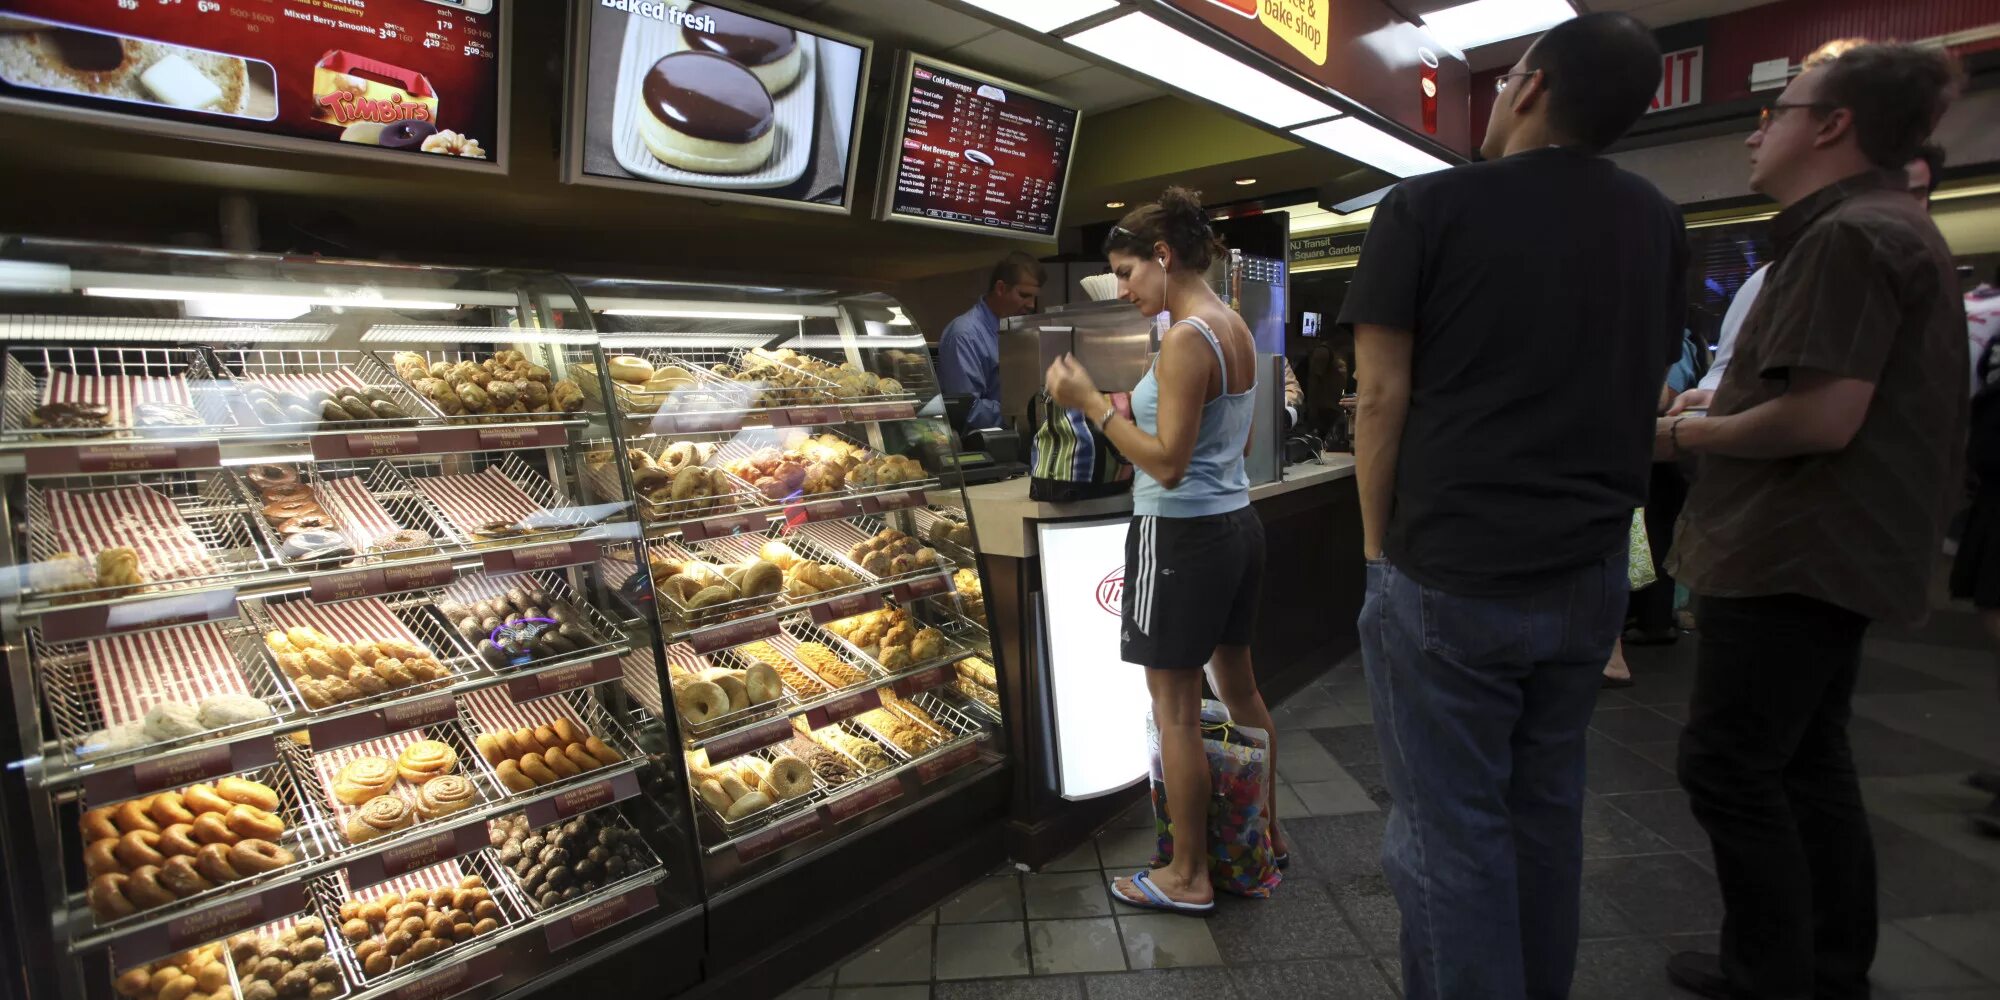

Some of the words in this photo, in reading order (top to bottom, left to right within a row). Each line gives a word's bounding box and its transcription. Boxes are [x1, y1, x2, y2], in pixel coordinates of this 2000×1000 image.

[322, 1, 364, 17] Strawberry
[437, 9, 452, 17] each
[283, 8, 311, 21] Mixed
[313, 15, 336, 27] Berry
[338, 20, 376, 34] Smoothie
[437, 20, 453, 30] 179
[465, 16, 476, 24] CAL
[669, 6, 716, 34] fresh
[1264, 0, 1293, 28] bake
[1296, 15, 1321, 50] shop
[379, 28, 396, 39] 349
[423, 38, 440, 49] 429
[464, 46, 480, 56] 509
[932, 75, 946, 85] Cold
[946, 79, 972, 93] Beverages
[922, 143, 932, 152] Hot
[932, 145, 959, 158] Beverages
[1290, 240, 1301, 250] NJ
[1303, 237, 1331, 249] Transit
[1294, 250, 1325, 260] Square
[1328, 244, 1361, 256] Garden
[1104, 577, 1124, 604] Ti
